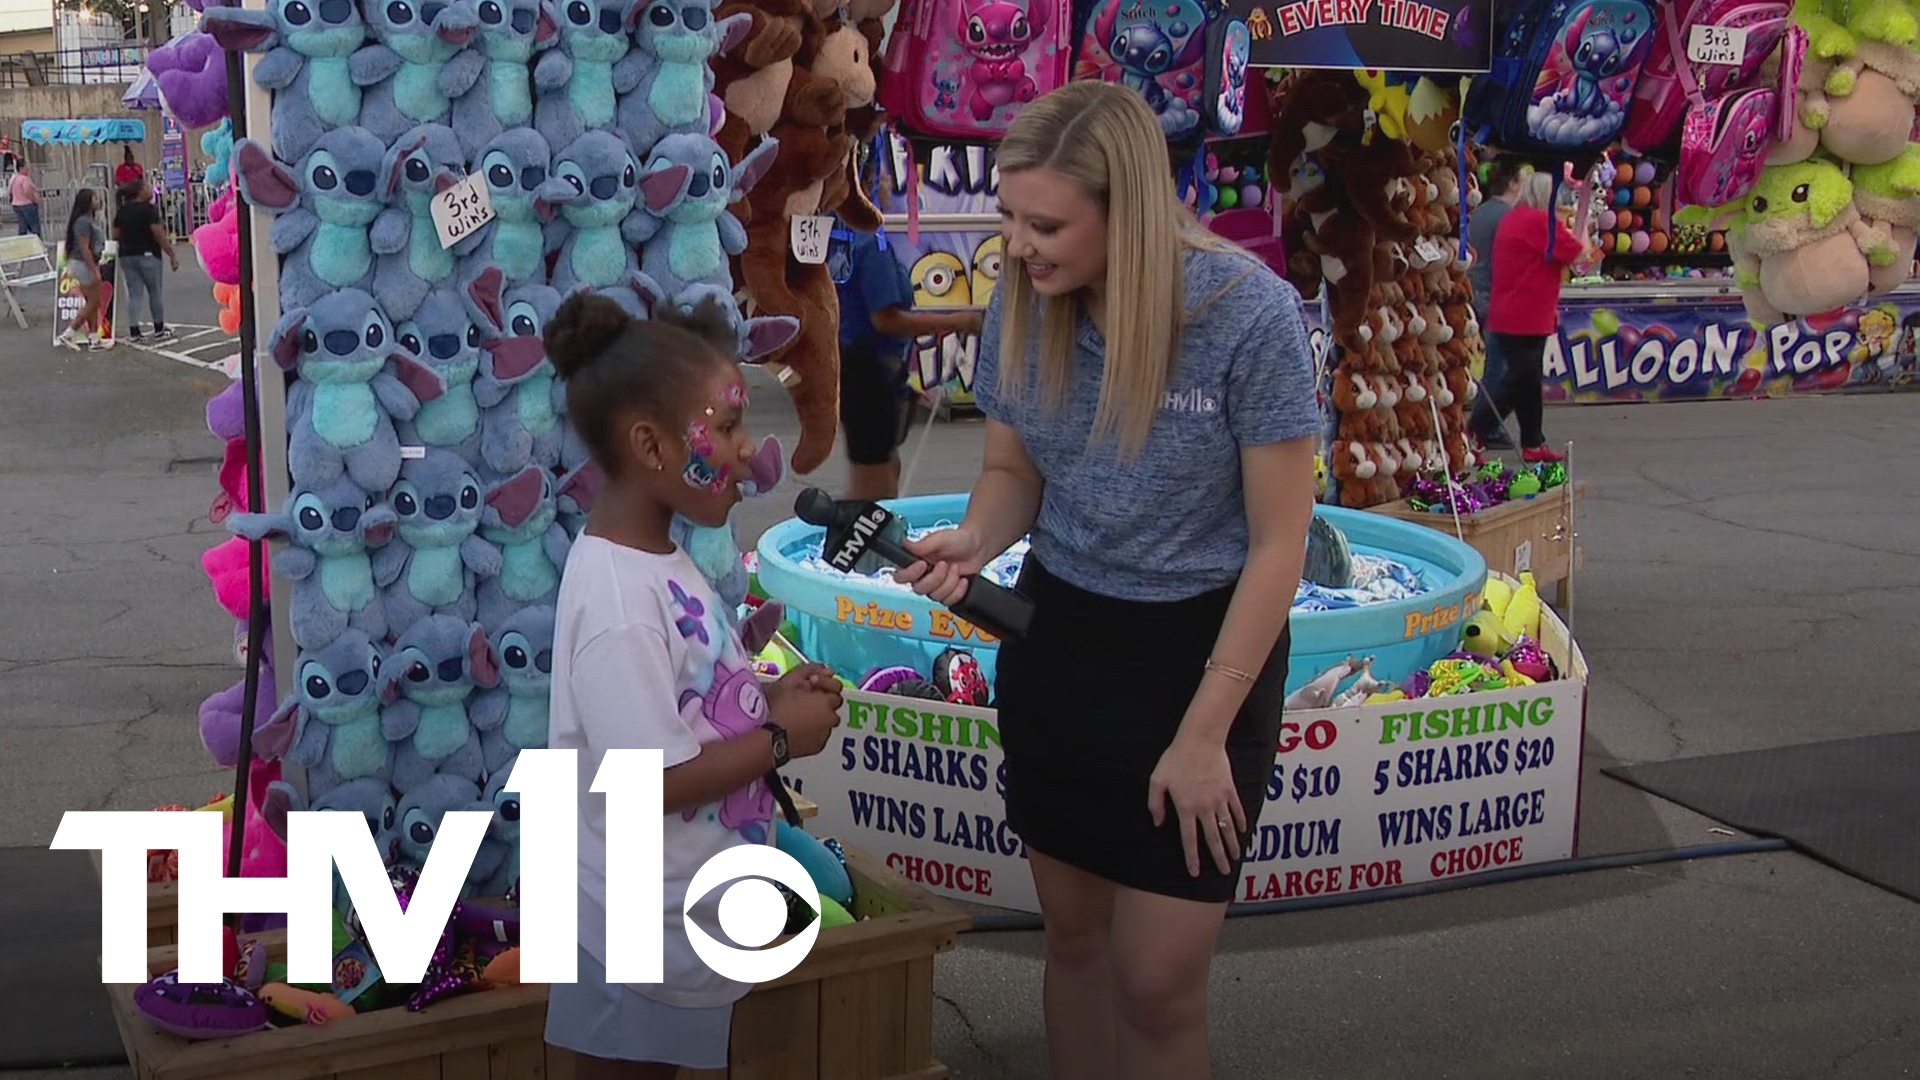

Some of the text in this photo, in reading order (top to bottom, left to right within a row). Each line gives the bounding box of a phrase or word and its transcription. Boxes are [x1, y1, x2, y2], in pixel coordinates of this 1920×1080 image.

[1276, 0, 1450, 41] EVERY TIME
[1703, 28, 1730, 46] 3rd
[443, 183, 479, 218] 3rd
[800, 219, 821, 242] 5th
[1543, 322, 1851, 390] ALLOON POP
[831, 514, 879, 567] THV11
[835, 594, 914, 631] Prize
[1403, 602, 1460, 640] Prize
[846, 699, 1004, 750] FISHIN
[1378, 696, 1555, 745] FISHING
[841, 736, 857, 772] 5
[863, 734, 989, 792] SHARKS
[1291, 763, 1341, 804] $10
[1374, 736, 1555, 796] 5 SHARKS $20
[848, 789, 926, 840] WINS
[1378, 789, 1546, 850] WINS LARGE
[1243, 818, 1342, 863] DIUM
[886, 852, 993, 897] CHOICE
[1244, 836, 1524, 902] LARGE FOR CHOICE
